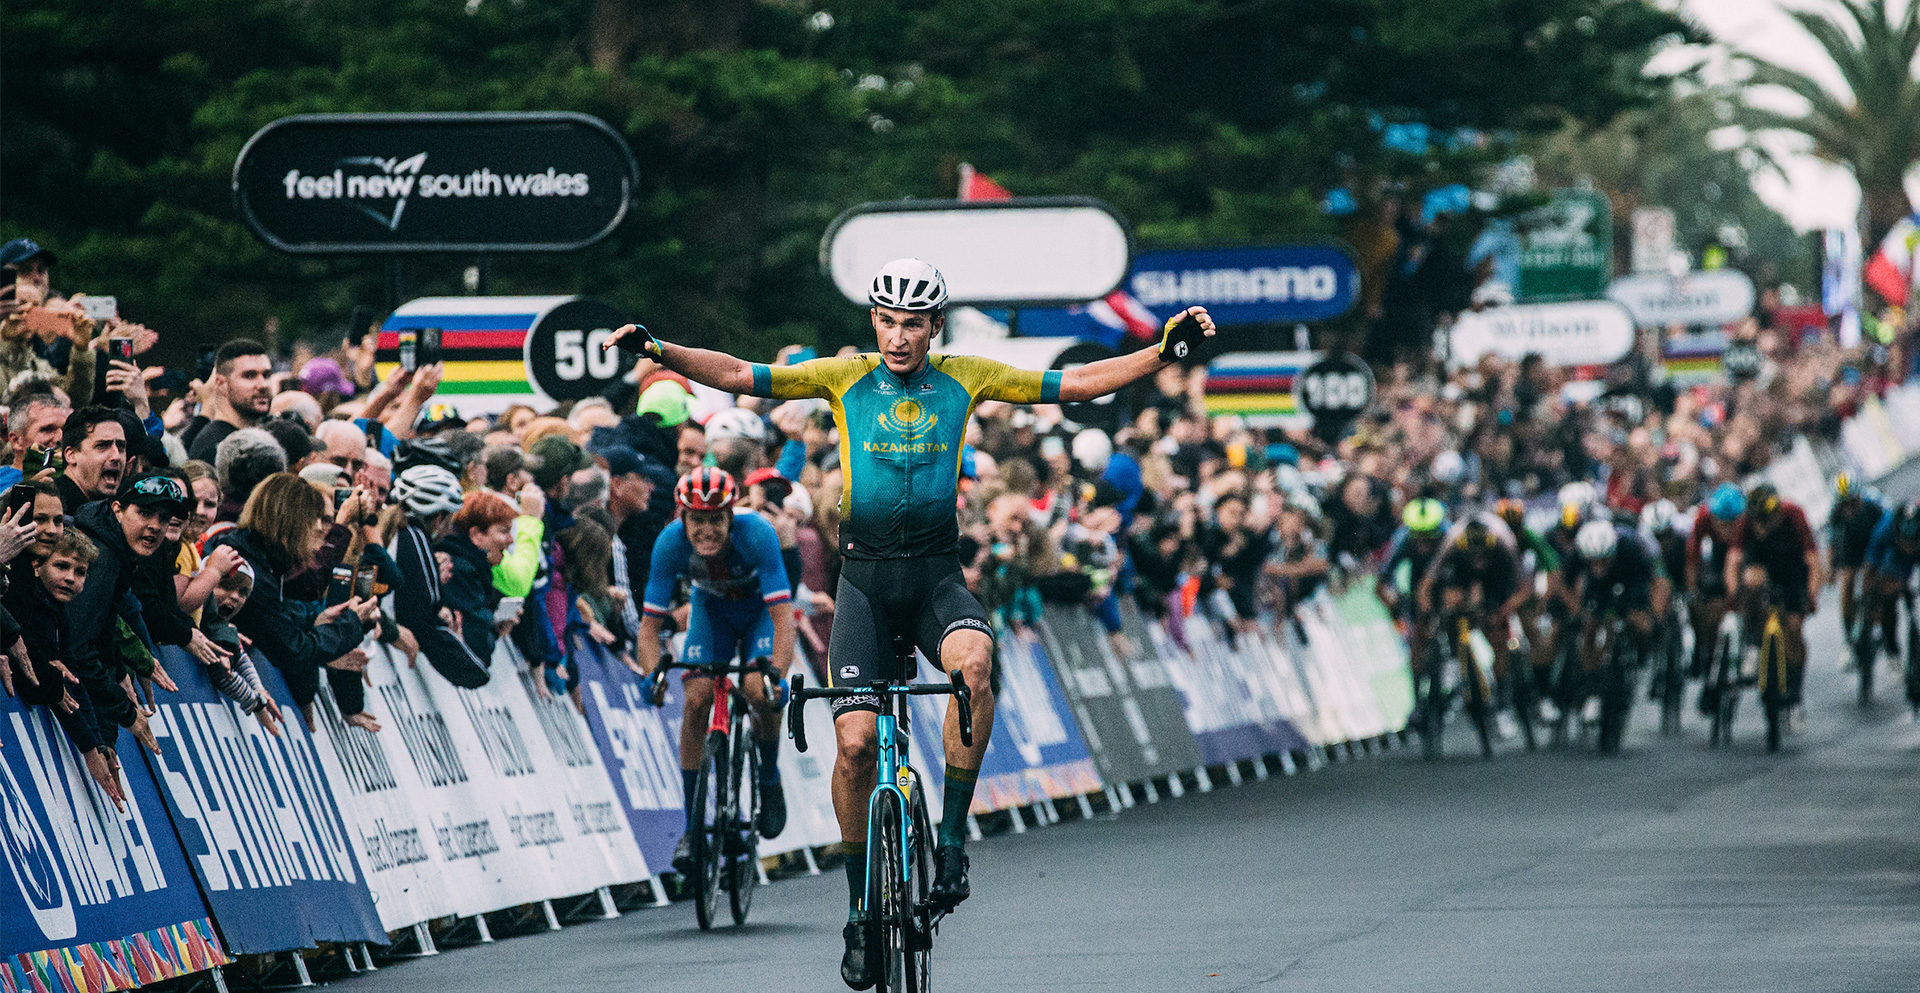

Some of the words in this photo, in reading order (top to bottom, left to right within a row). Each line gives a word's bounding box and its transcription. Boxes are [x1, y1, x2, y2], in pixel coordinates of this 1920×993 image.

[283, 168, 343, 199] feel
[346, 175, 414, 199] new
[419, 167, 502, 198] south
[504, 167, 590, 198] wales
[1131, 265, 1338, 304] SHIMANO
[553, 328, 619, 381] 50
[863, 441, 949, 454] KAZAKHSTAN
[378, 682, 469, 789] Wilson
[147, 701, 356, 892] SHIMANO
